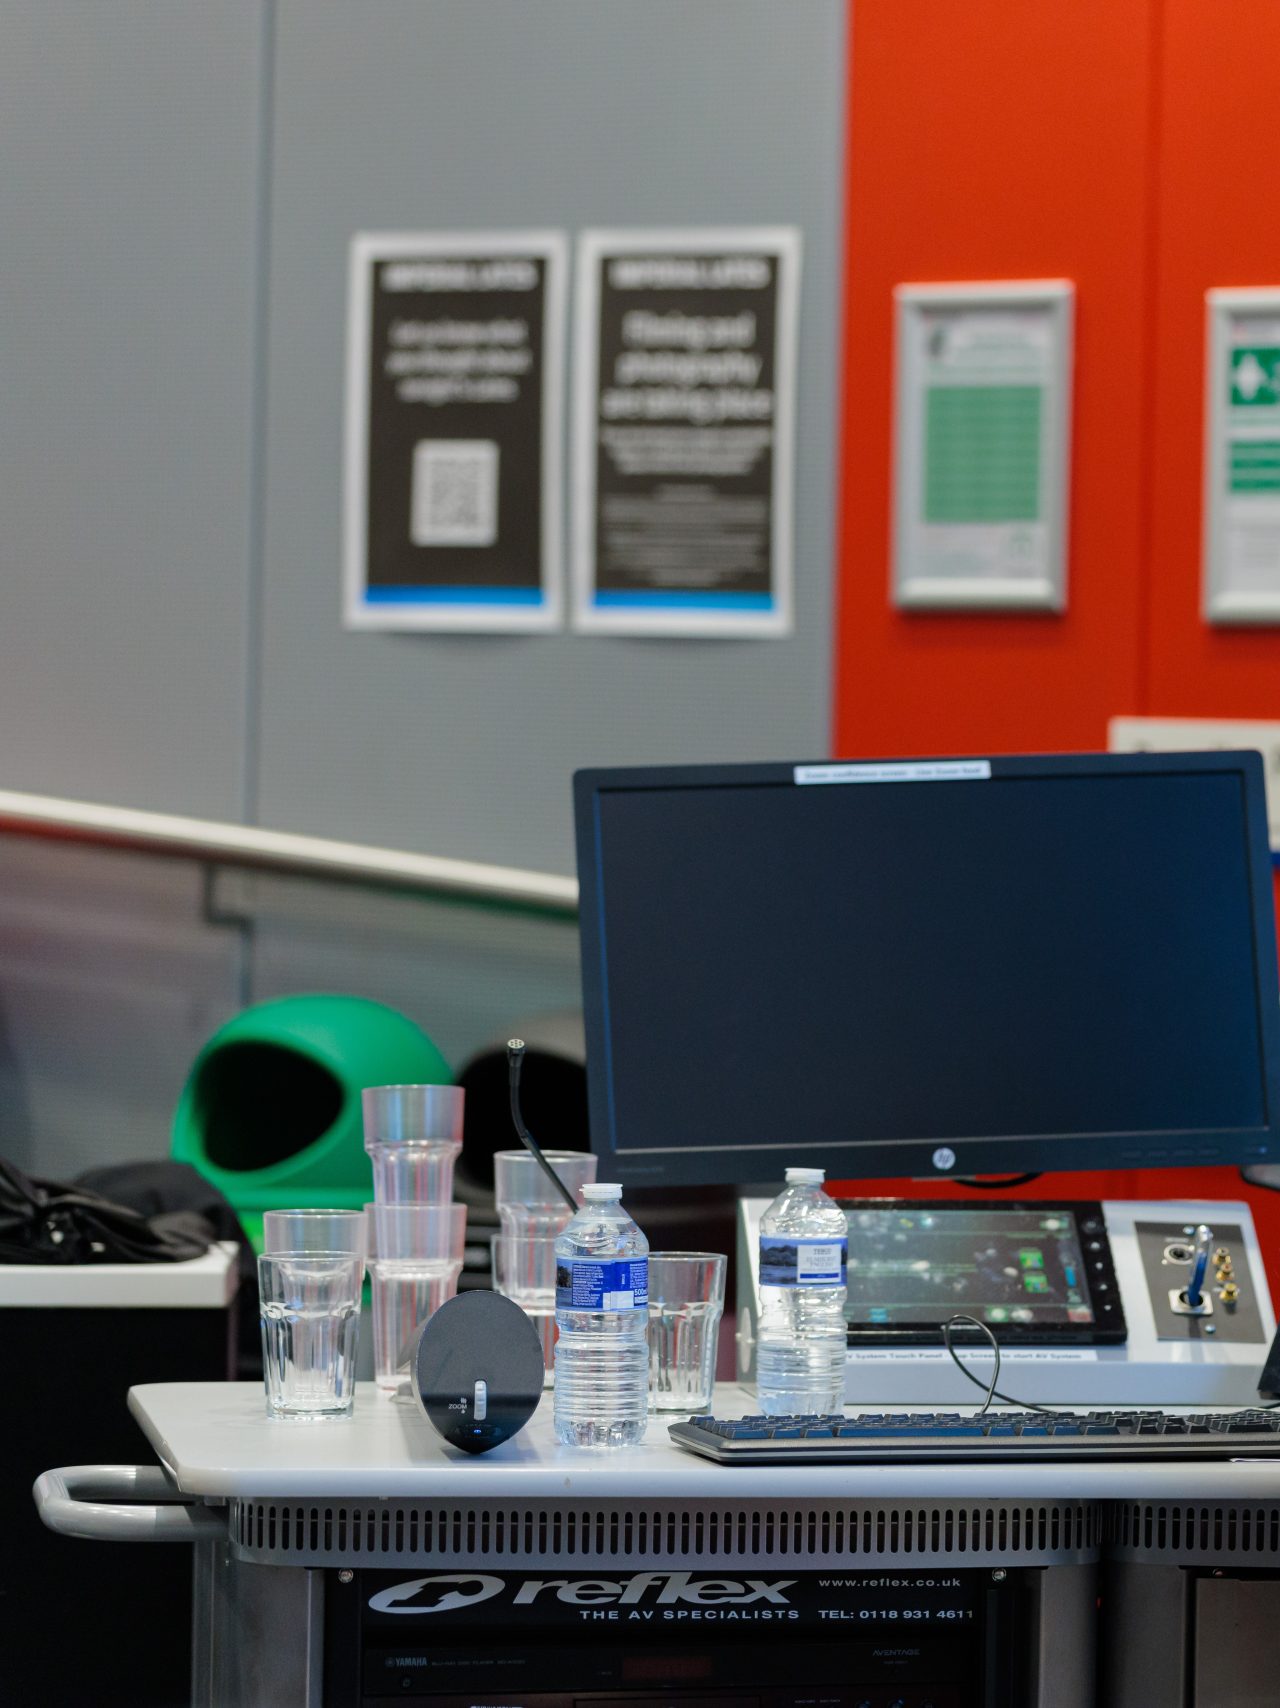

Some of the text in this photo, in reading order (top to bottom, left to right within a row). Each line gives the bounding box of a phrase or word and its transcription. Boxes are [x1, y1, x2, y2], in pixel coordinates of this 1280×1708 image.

[818, 1577, 961, 1588] www.reflex.co.uk
[512, 1571, 799, 1605] reflex
[579, 1610, 800, 1619] THE AV SPECIALISTS
[817, 1610, 974, 1619] TEL: 0118 931 4611
[395, 1657, 428, 1667] YAMAHA
